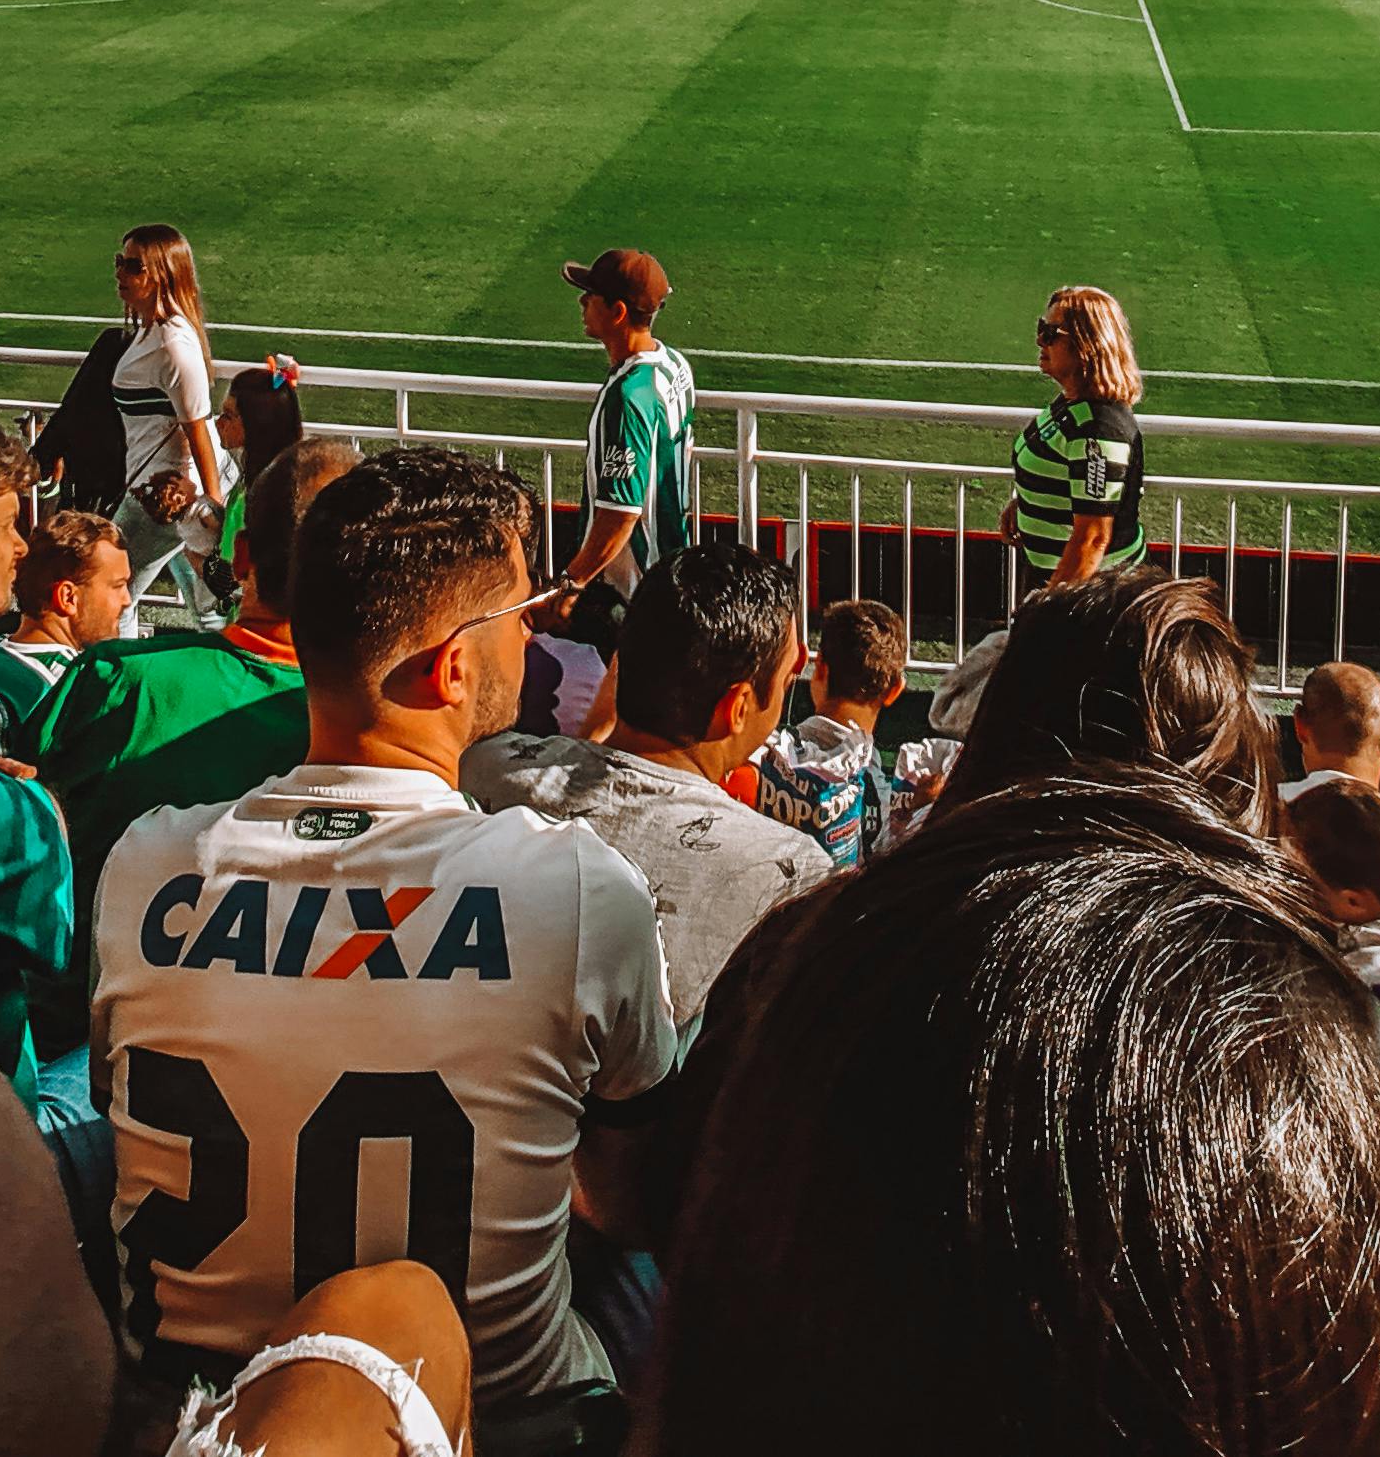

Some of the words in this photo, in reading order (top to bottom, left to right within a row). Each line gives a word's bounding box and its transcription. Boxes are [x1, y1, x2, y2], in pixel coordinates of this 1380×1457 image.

[1086, 461, 1097, 495] PRO
[1096, 455, 1107, 497] TORK
[139, 872, 512, 981] CAIXA
[118, 1043, 476, 1341] 20
